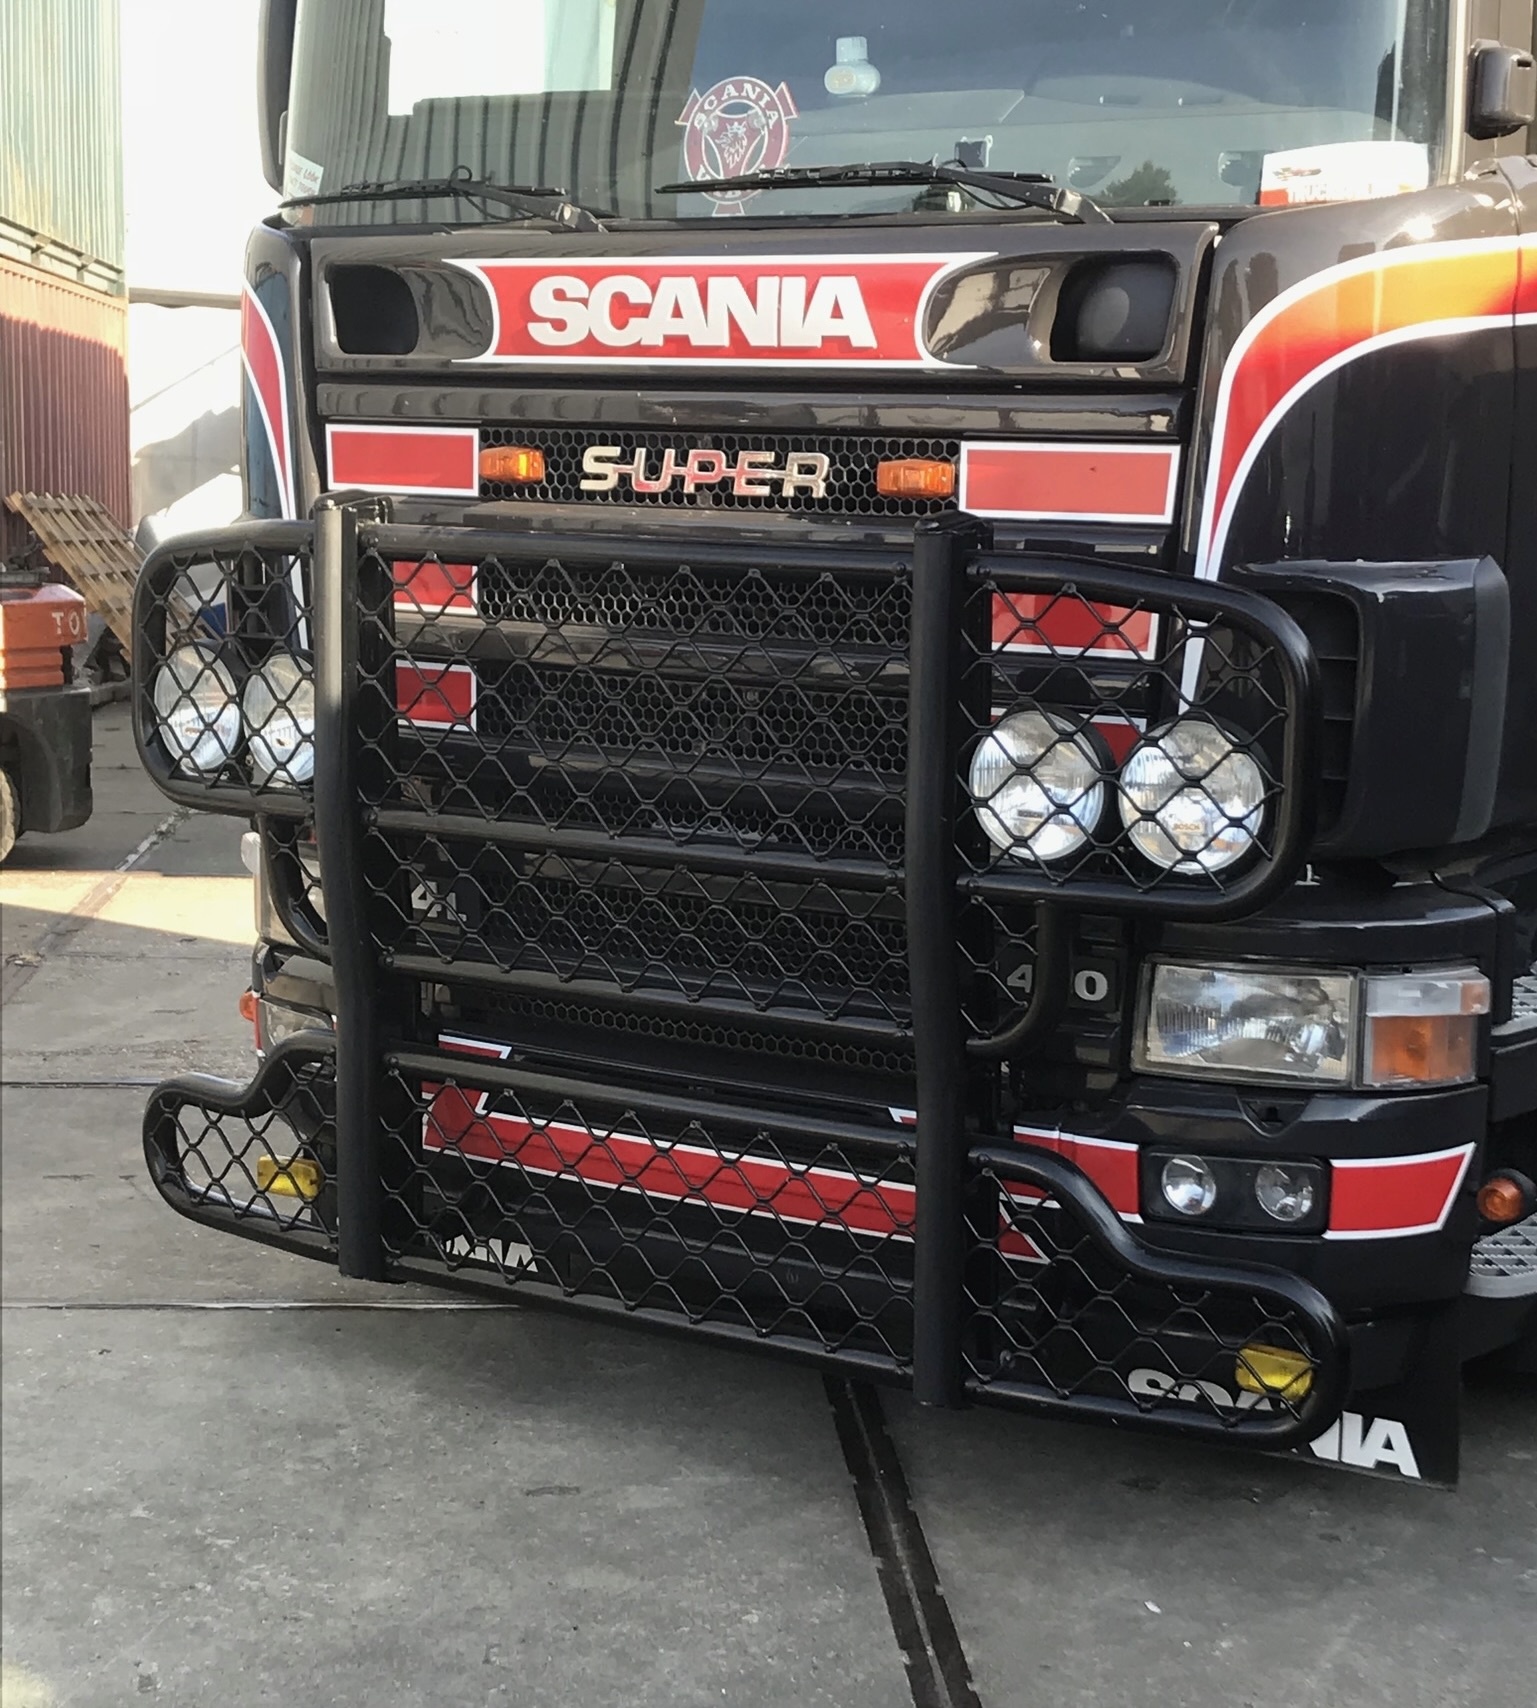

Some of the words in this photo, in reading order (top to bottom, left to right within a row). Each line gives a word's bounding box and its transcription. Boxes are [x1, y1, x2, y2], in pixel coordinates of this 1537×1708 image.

[694, 83, 779, 129] SCANIA
[527, 275, 878, 349] SCANIA
[579, 446, 831, 498] SUPER
